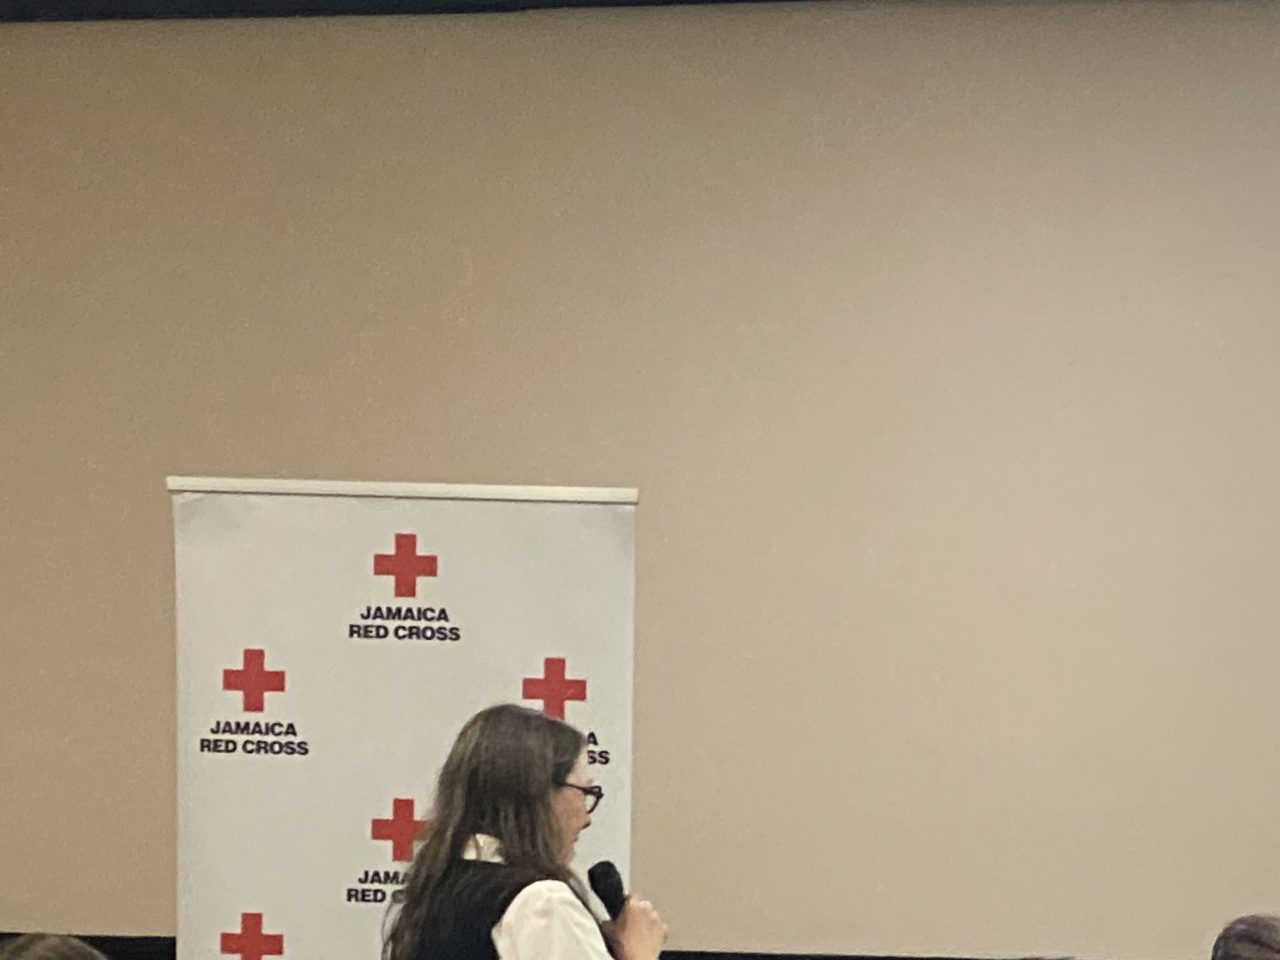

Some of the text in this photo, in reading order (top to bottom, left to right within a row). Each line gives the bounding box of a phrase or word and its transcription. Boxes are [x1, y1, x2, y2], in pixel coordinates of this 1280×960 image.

[360, 606, 449, 622] JAMAICA
[348, 624, 461, 642] RED CROSS
[210, 720, 298, 737] JAMAICA
[200, 738, 309, 756] RED CROSS
[346, 888, 387, 903] RED
